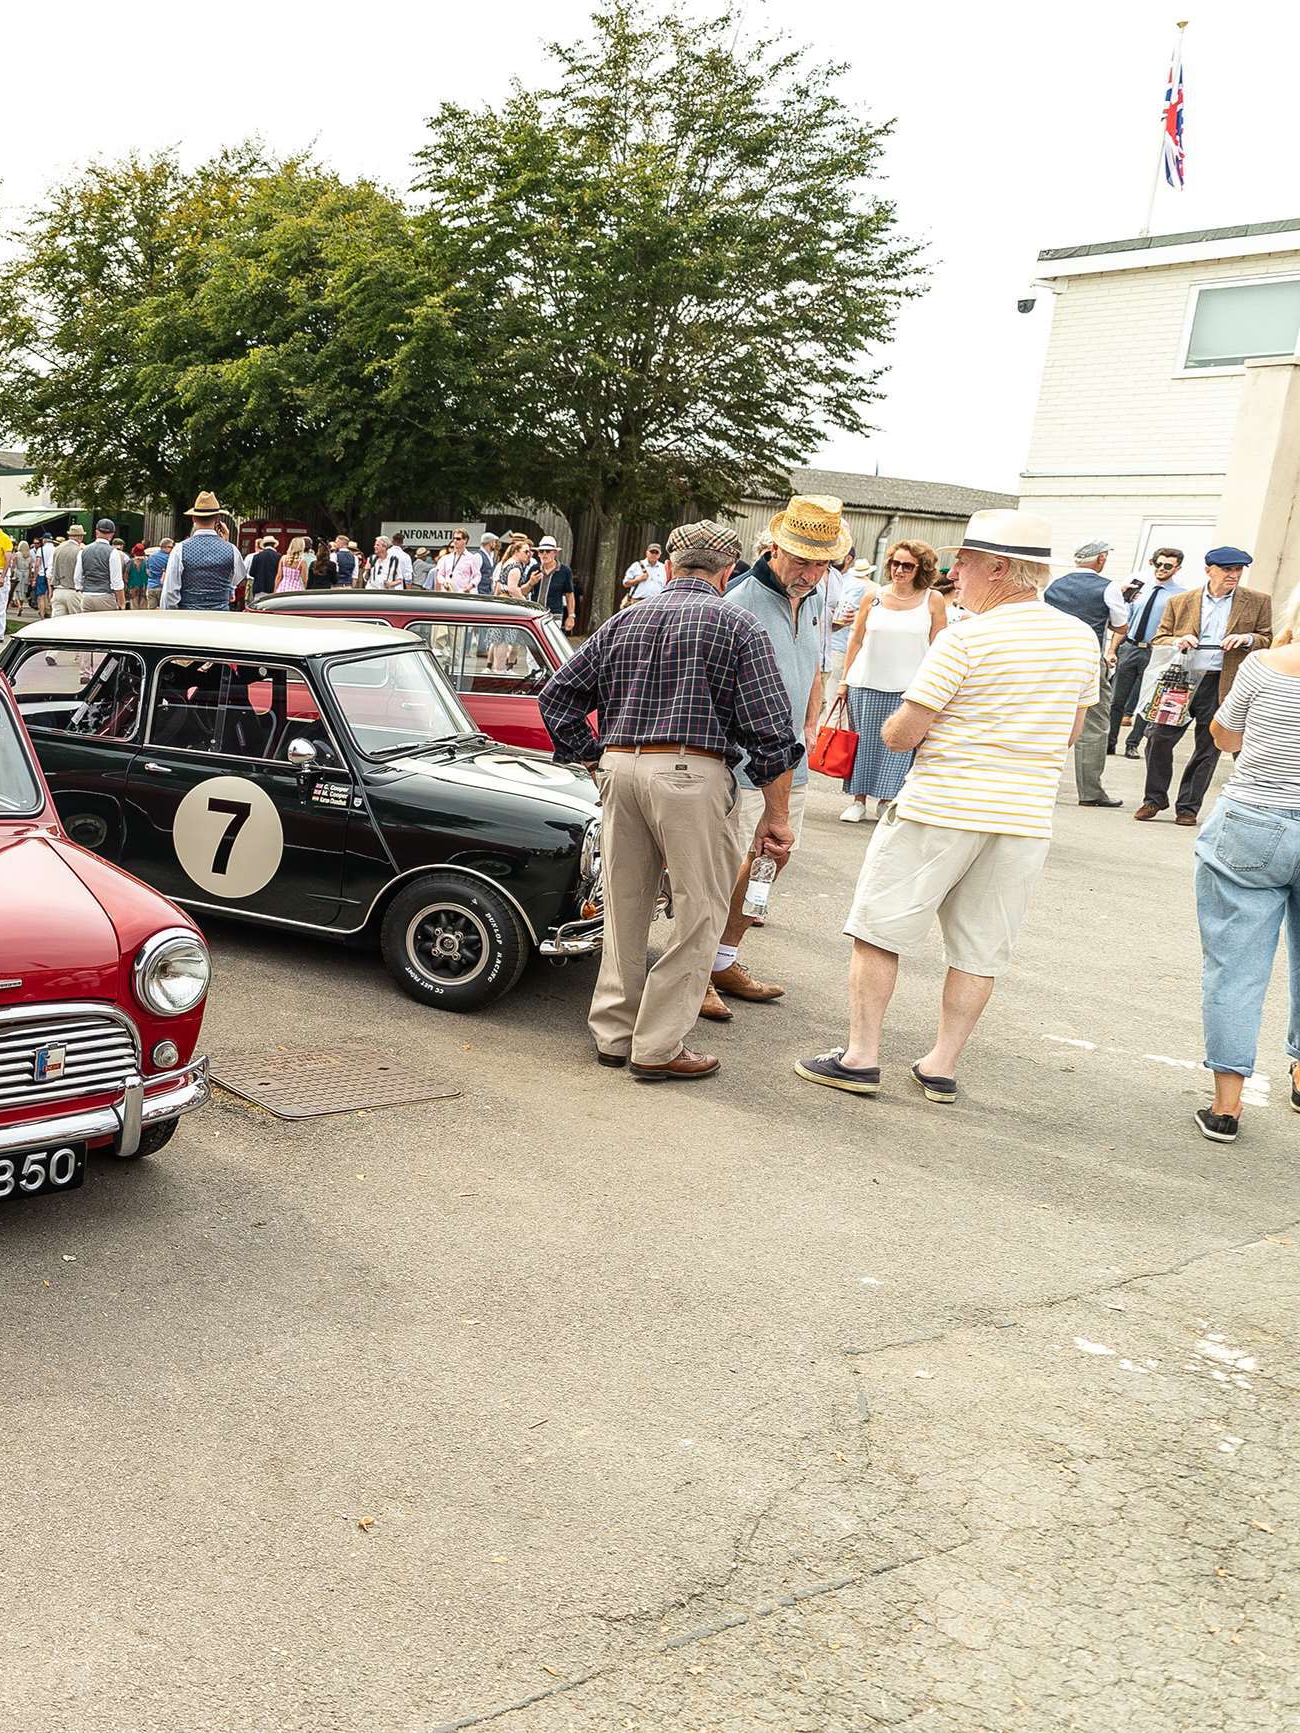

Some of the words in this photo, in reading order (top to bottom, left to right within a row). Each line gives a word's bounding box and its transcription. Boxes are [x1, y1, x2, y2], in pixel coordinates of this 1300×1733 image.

[400, 530, 453, 540] INFORMATI
[330, 791, 348, 799] Cooper
[207, 797, 251, 875] 7
[484, 912, 503, 945] DUNLOP
[487, 951, 503, 983] RACING
